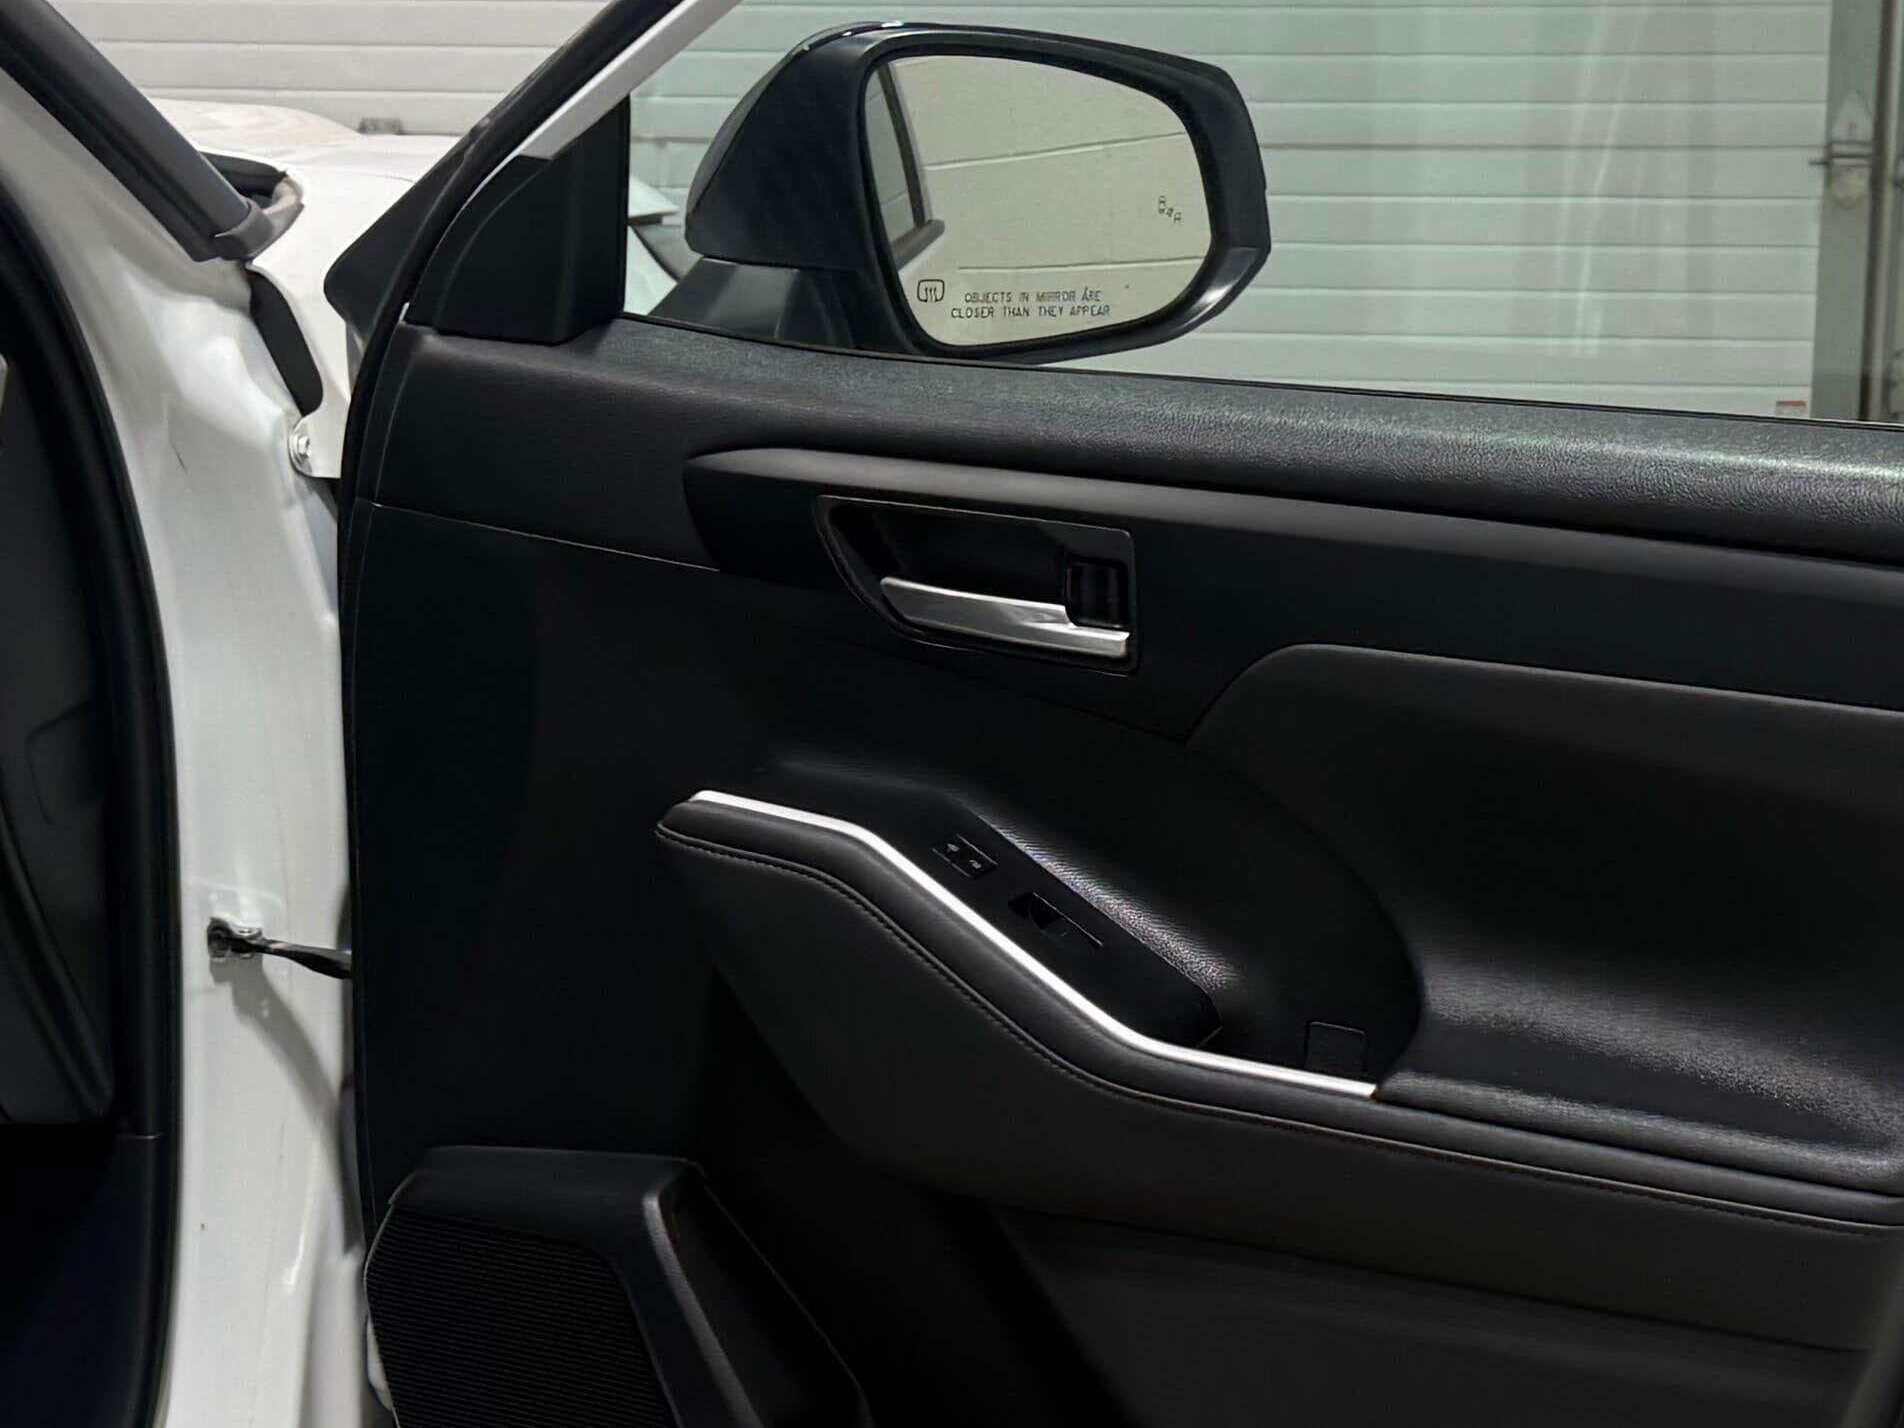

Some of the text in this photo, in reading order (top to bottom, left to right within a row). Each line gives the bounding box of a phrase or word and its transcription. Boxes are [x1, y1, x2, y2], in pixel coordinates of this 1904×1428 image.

[964, 287, 1101, 304] OBJECTS IN MIRROR ARE
[950, 304, 1111, 319] CLOSER THAN THEY APPEAR
